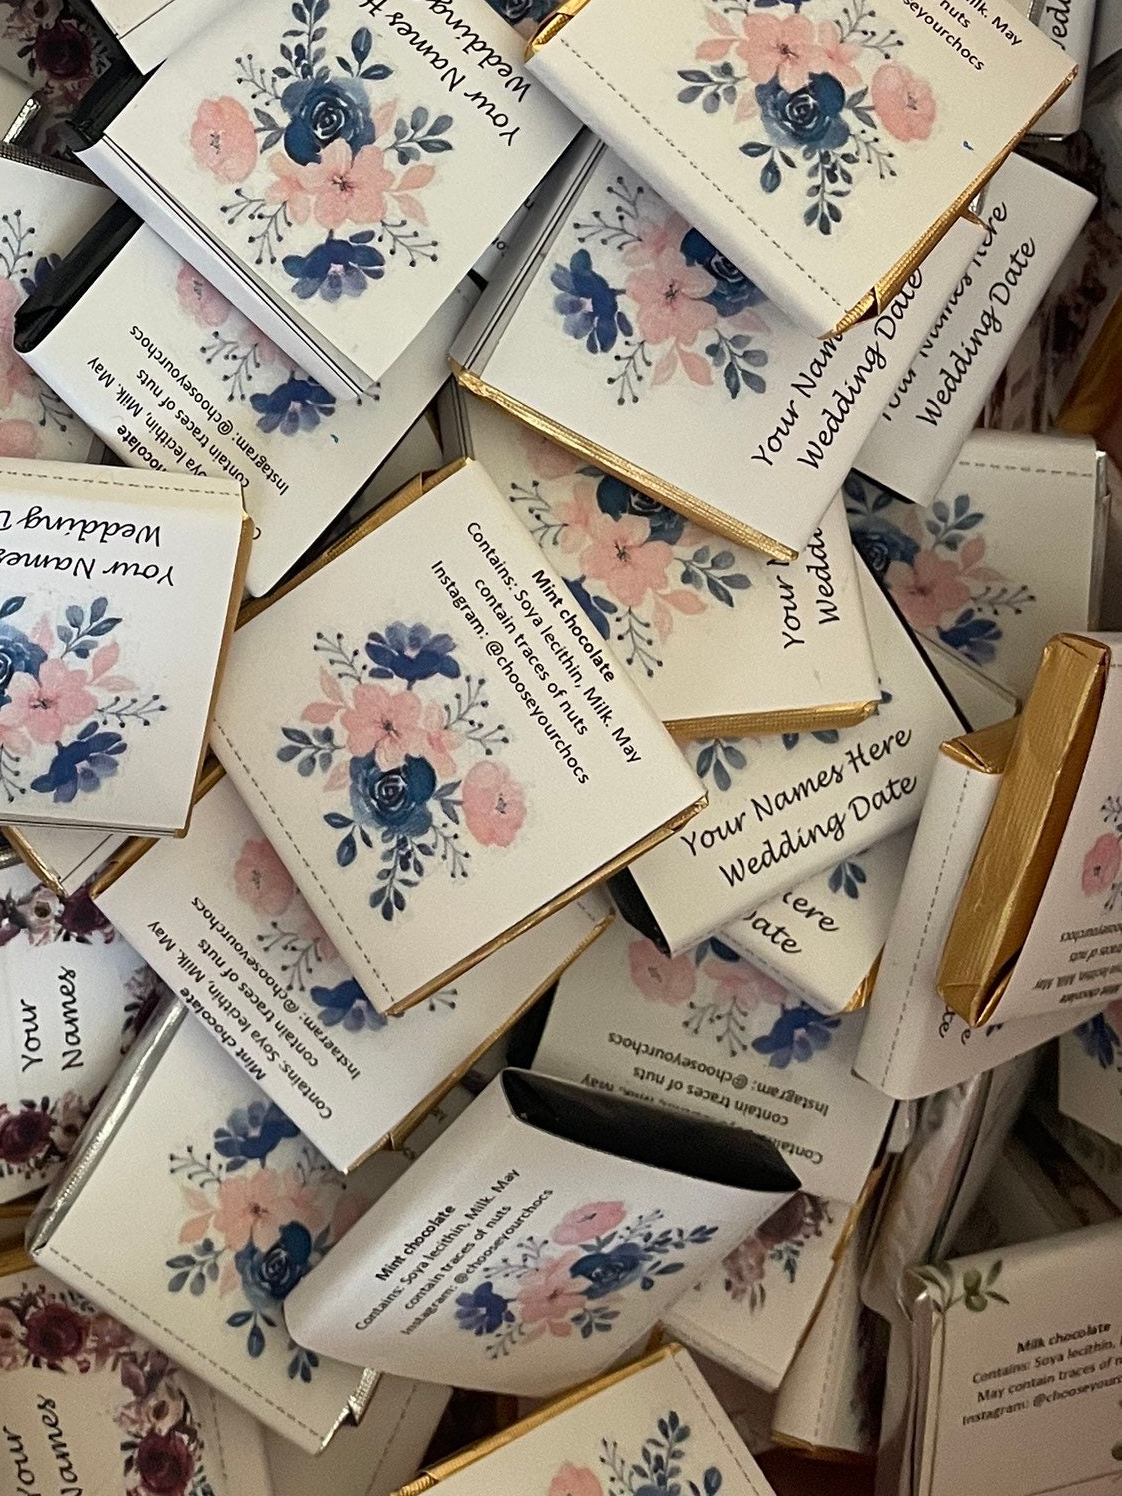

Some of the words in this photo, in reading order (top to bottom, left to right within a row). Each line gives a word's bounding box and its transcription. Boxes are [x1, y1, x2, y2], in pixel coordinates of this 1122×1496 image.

[385, 11, 466, 92] Names
[991, 15, 1023, 46] May
[463, 91, 521, 147] Your
[915, 305, 1003, 427] Wedding
[988, 237, 1036, 306] Date
[750, 399, 799, 466] Your
[796, 340, 887, 470] Wedding
[16, 505, 161, 548] Wedding
[102, 561, 174, 587] Your
[431, 560, 489, 640] Instagram:
[485, 640, 590, 784] @chooseyourchocs
[467, 522, 518, 591] Contains:
[513, 589, 544, 628] Soya
[540, 625, 583, 688] lecithin,
[583, 686, 613, 728] Milk.
[611, 726, 642, 763] May
[531, 569, 564, 609] Mint
[559, 609, 615, 683] chocolate
[679, 811, 747, 857] Your
[750, 764, 844, 822] Names
[844, 729, 912, 774] Here
[718, 812, 847, 888] Wedding
[847, 776, 917, 822] Date
[20, 998, 44, 1073] Your
[57, 965, 84, 1071] Names
